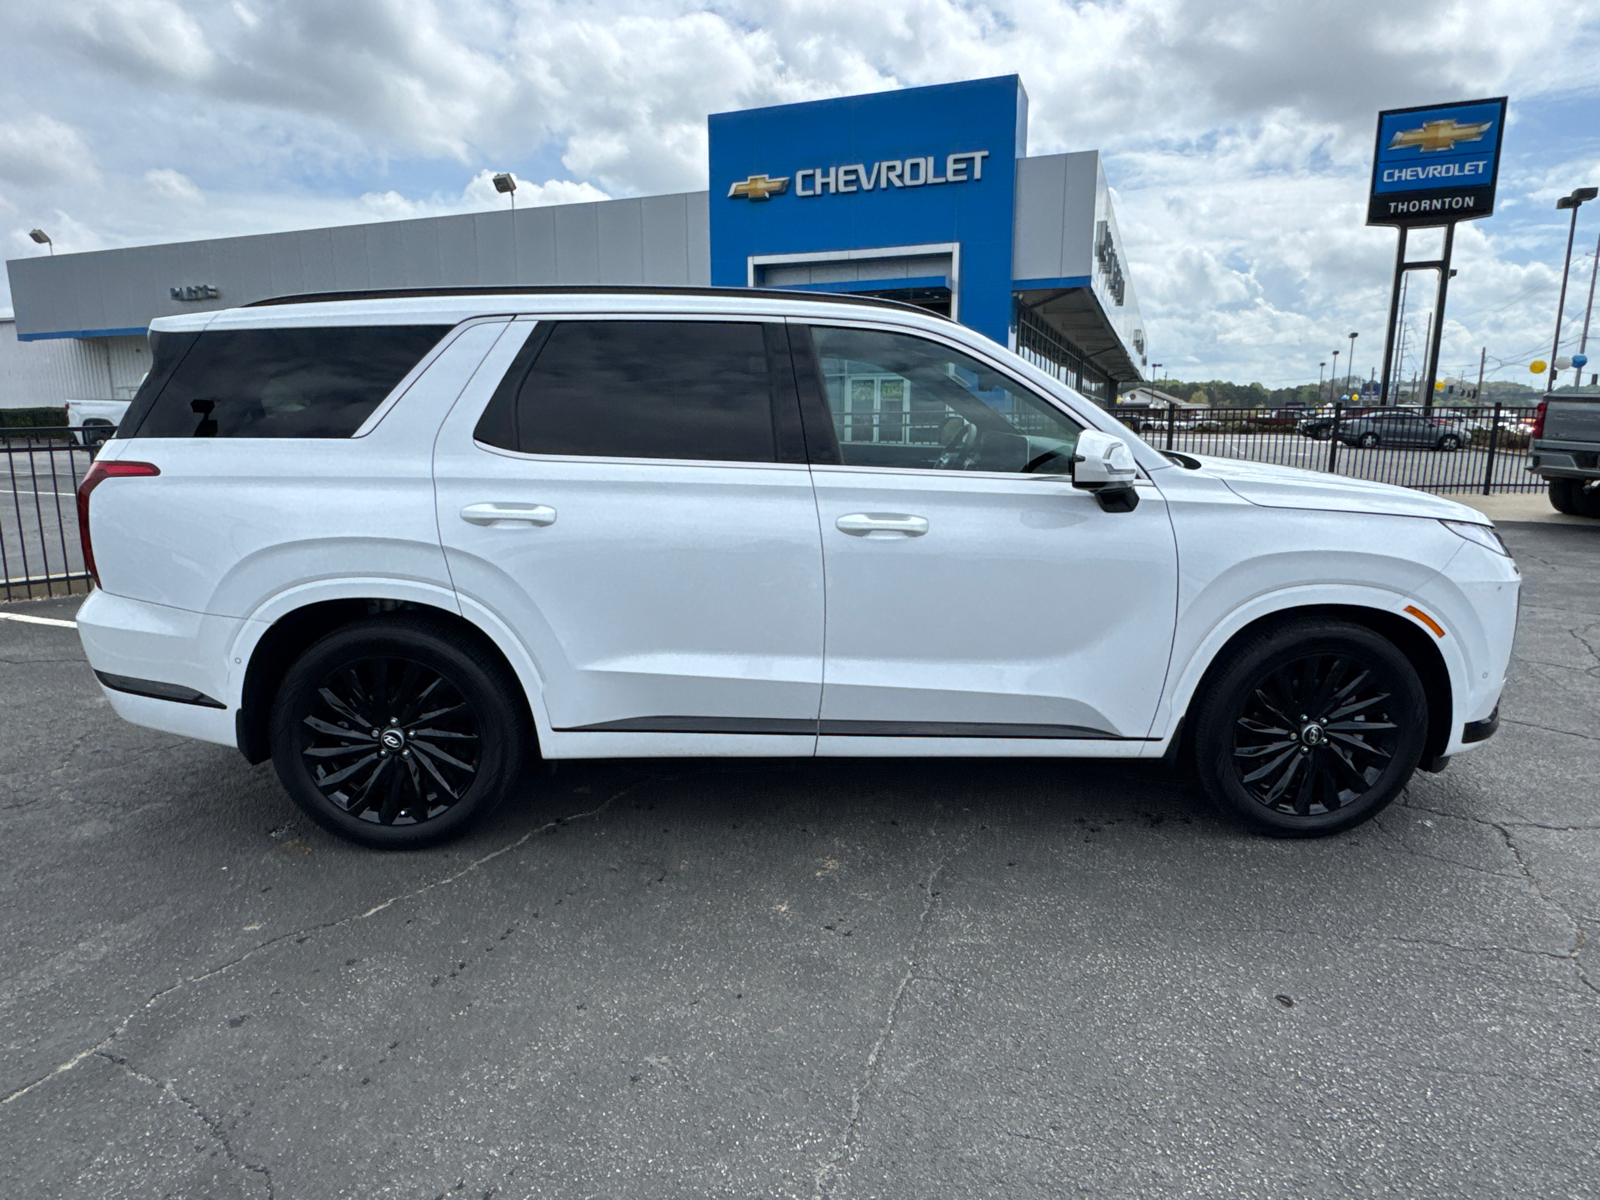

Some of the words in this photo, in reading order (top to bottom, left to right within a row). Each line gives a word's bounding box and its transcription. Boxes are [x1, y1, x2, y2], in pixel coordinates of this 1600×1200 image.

[795, 150, 989, 197] CHEVROLET
[1382, 160, 1488, 183] CHEVROLET
[1388, 196, 1475, 214] THORNTON
